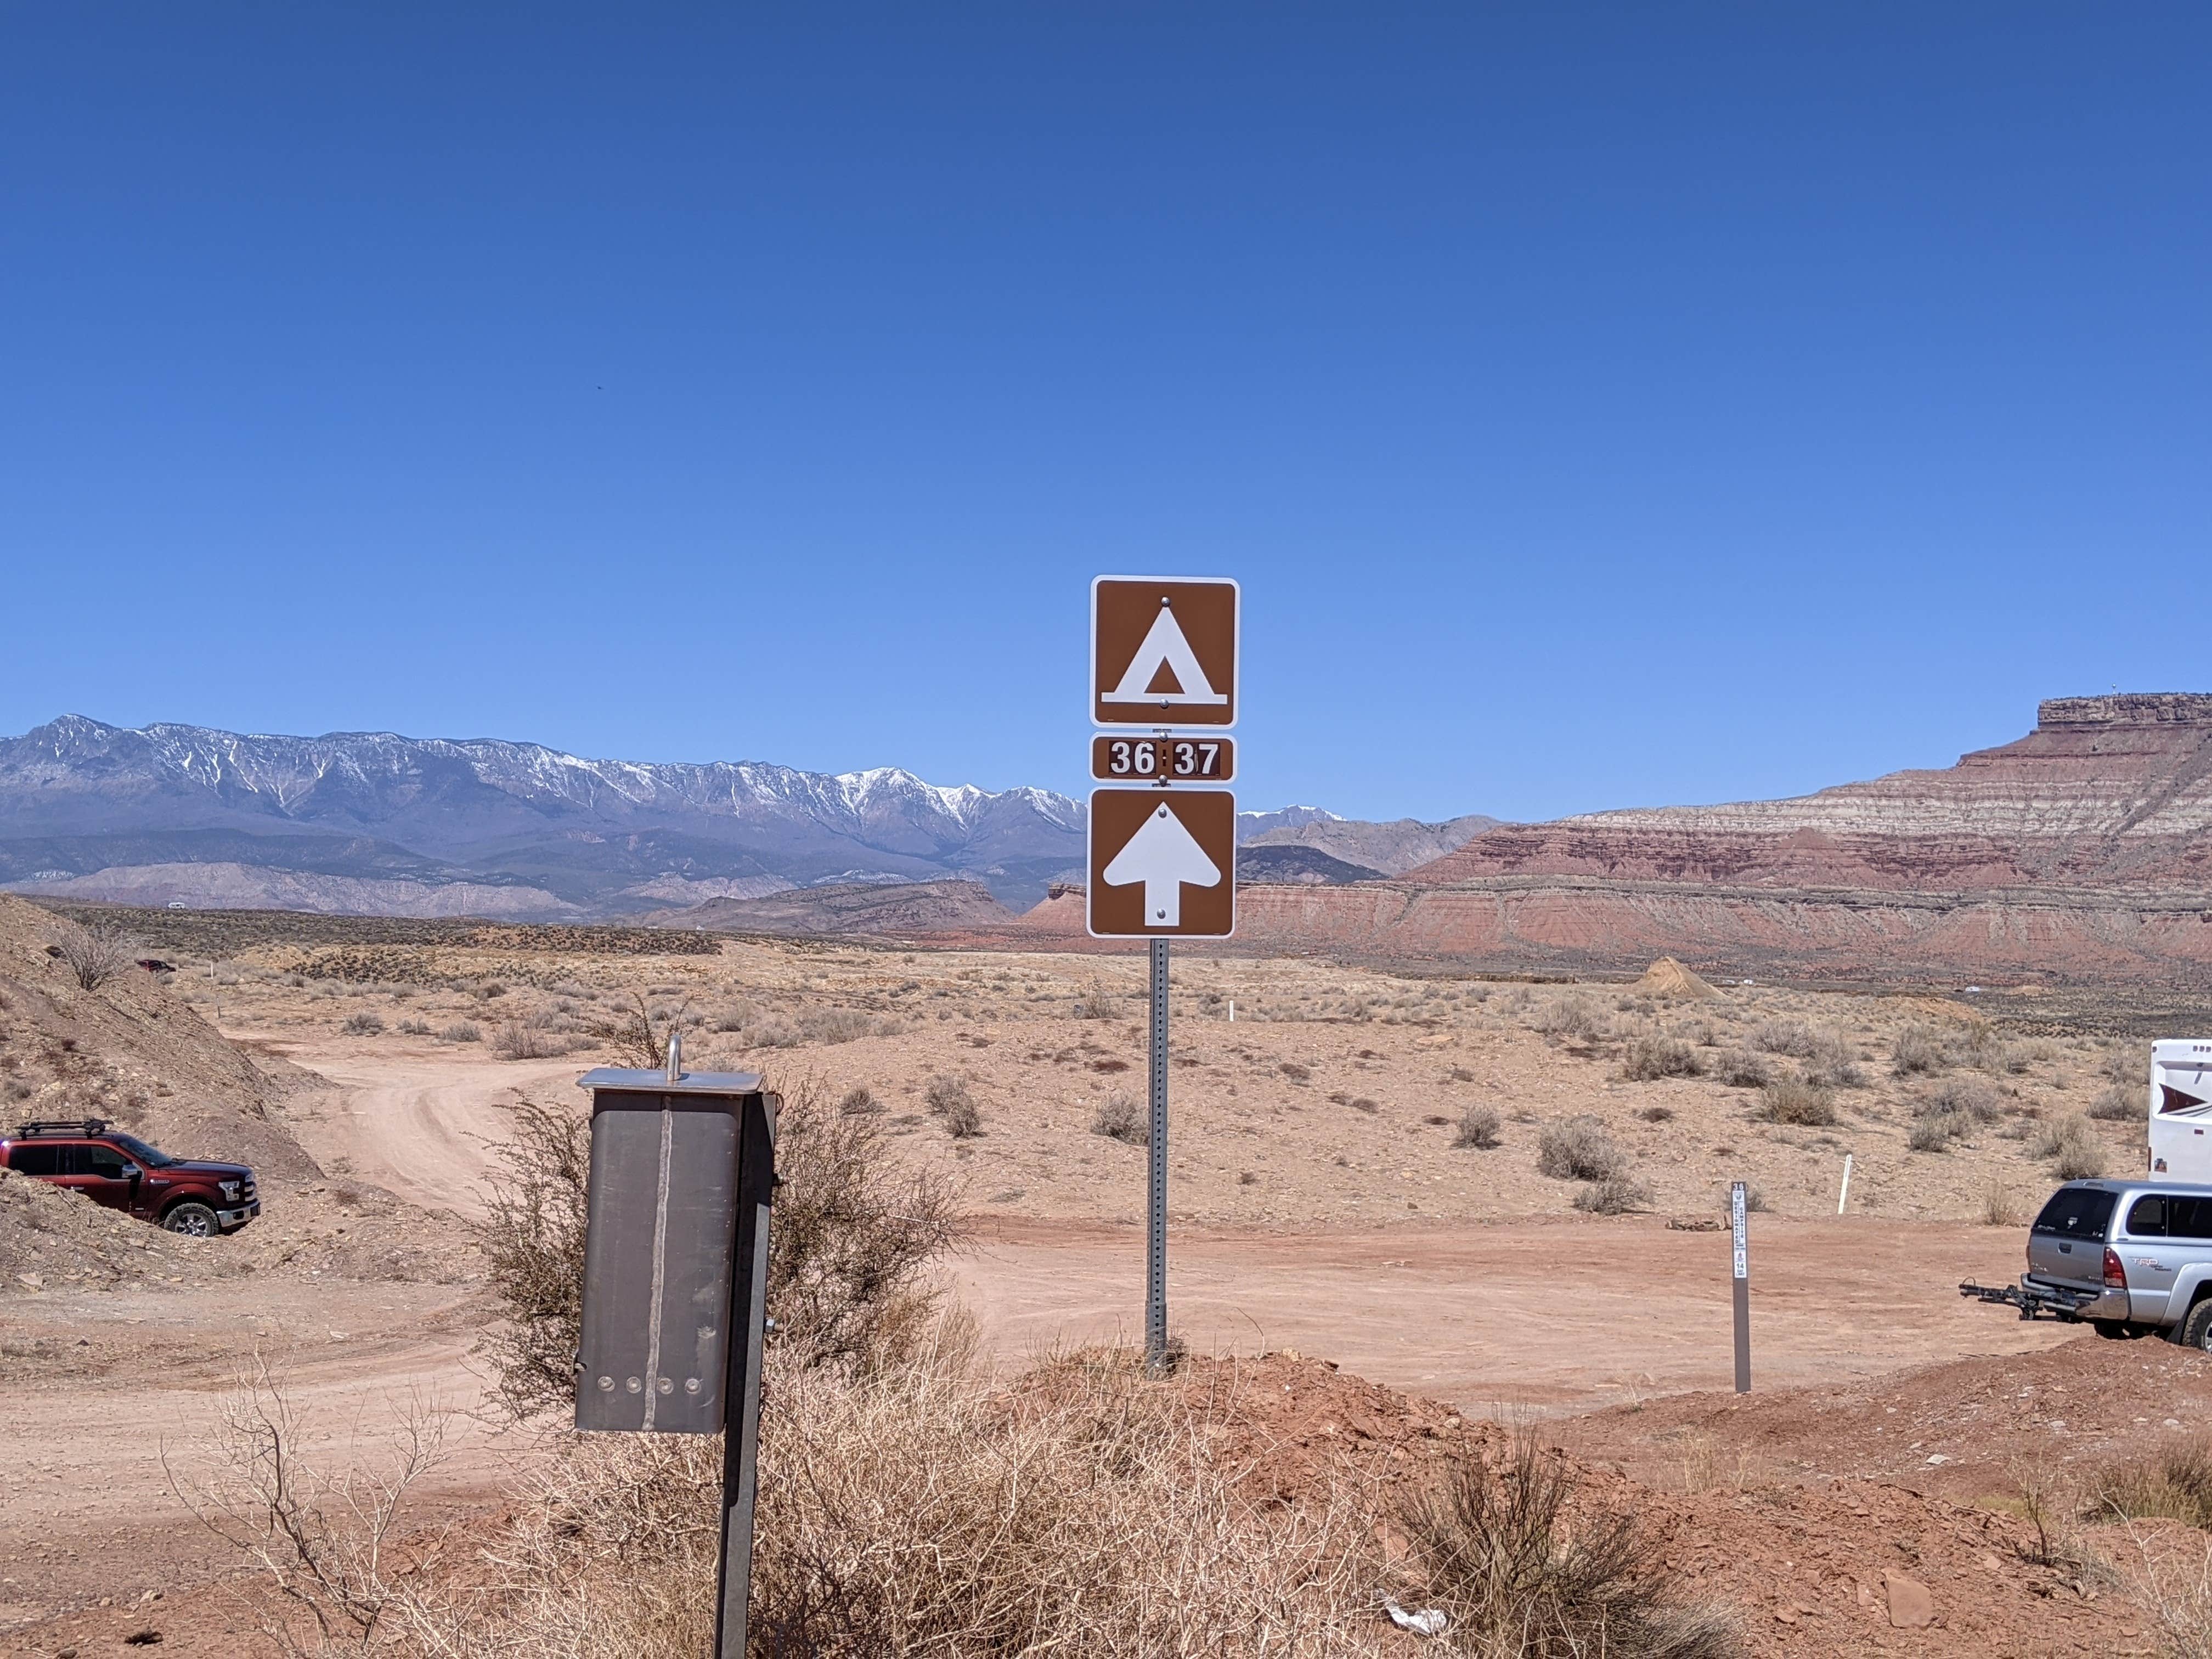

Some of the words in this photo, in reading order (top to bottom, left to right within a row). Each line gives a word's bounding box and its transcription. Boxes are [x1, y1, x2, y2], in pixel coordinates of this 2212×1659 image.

[1110, 741, 1155, 774] 36
[1174, 742, 1219, 775] 37
[2132, 1258, 2158, 1266] TRD
